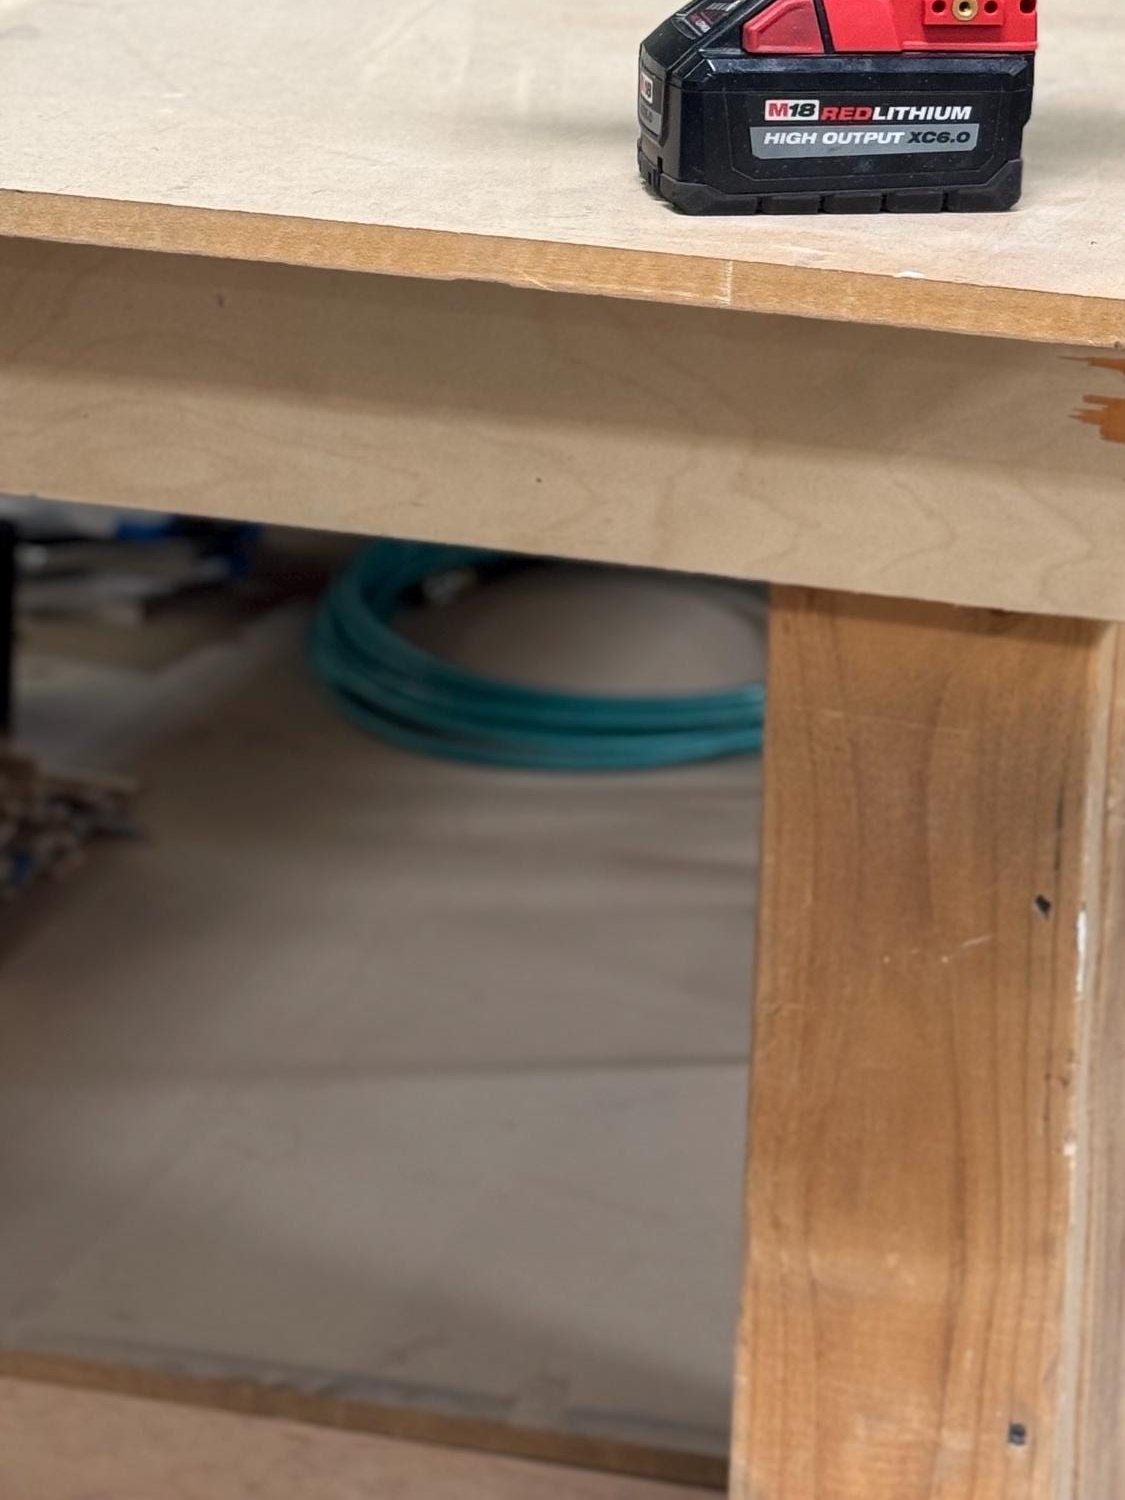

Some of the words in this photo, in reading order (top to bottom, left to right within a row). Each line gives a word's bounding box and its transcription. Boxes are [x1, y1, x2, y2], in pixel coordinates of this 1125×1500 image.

[767, 102, 817, 118] M18
[763, 131, 818, 145] HIGH
[821, 131, 905, 145] OUTPUT
[907, 130, 971, 144] XC6.0
